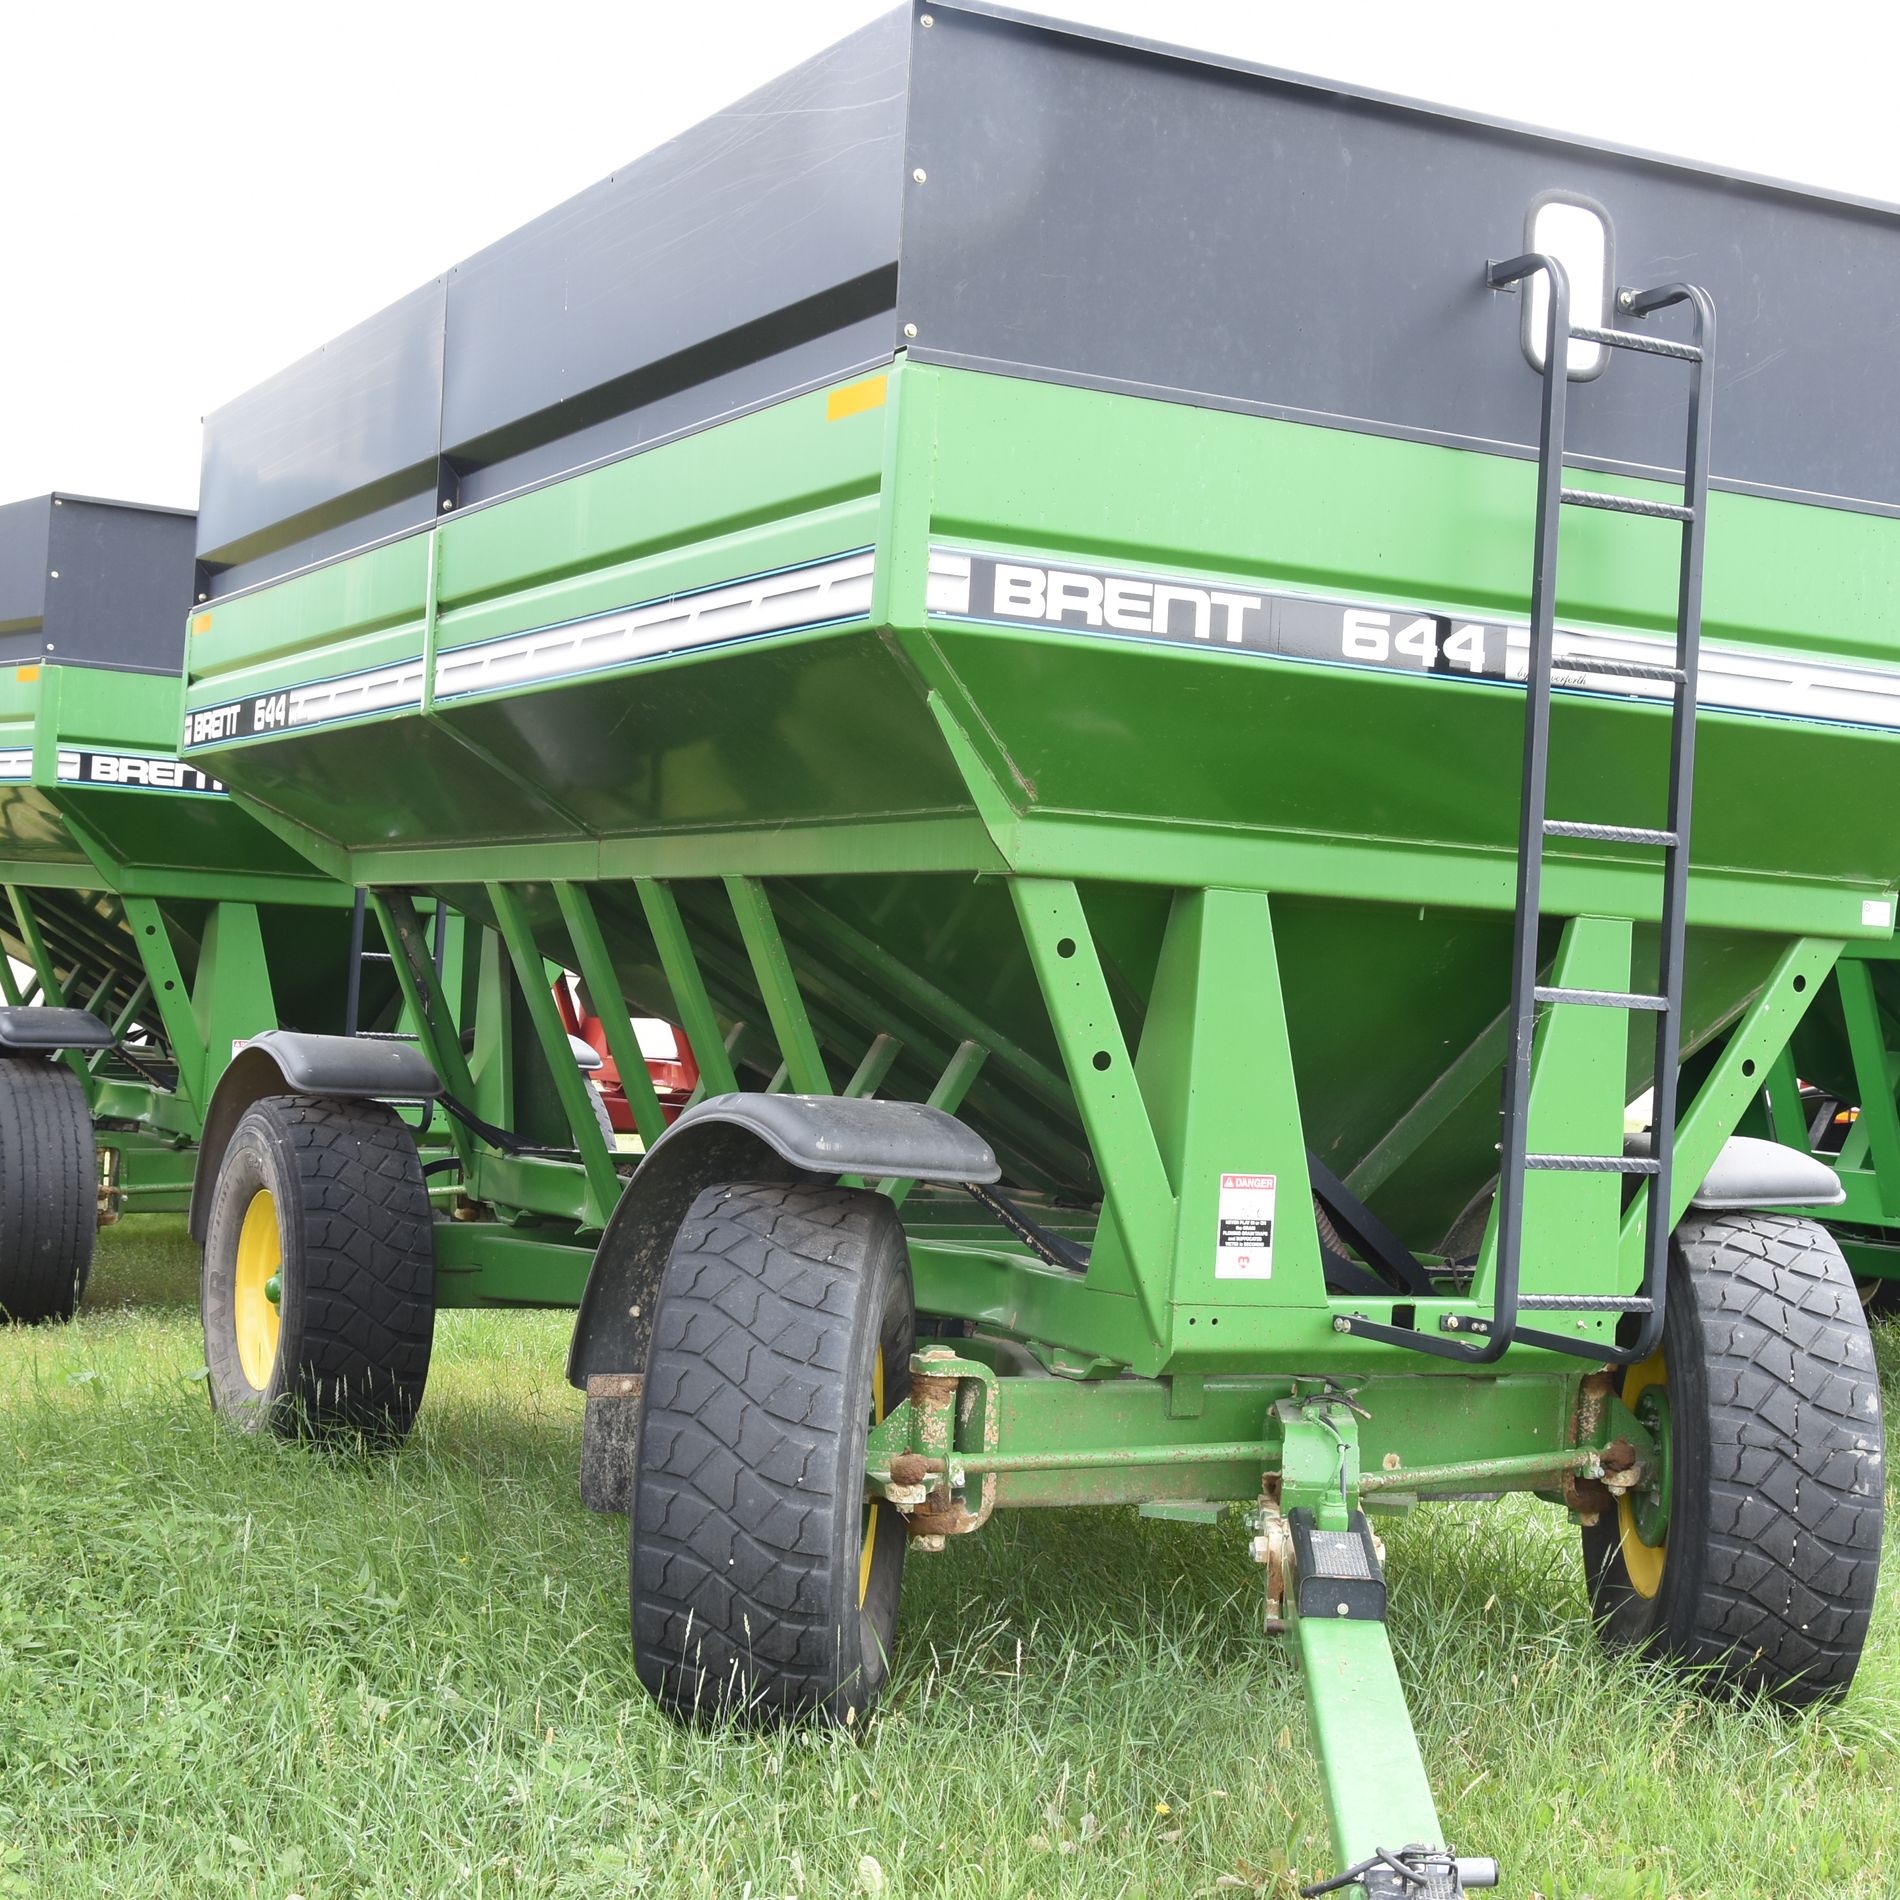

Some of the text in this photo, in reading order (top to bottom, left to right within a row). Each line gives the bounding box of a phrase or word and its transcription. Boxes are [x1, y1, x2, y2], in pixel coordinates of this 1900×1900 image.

[993, 563, 1486, 674] BRENT 644
[193, 693, 287, 743] BRENT 644
[1235, 1177, 1273, 1189] DANGER
